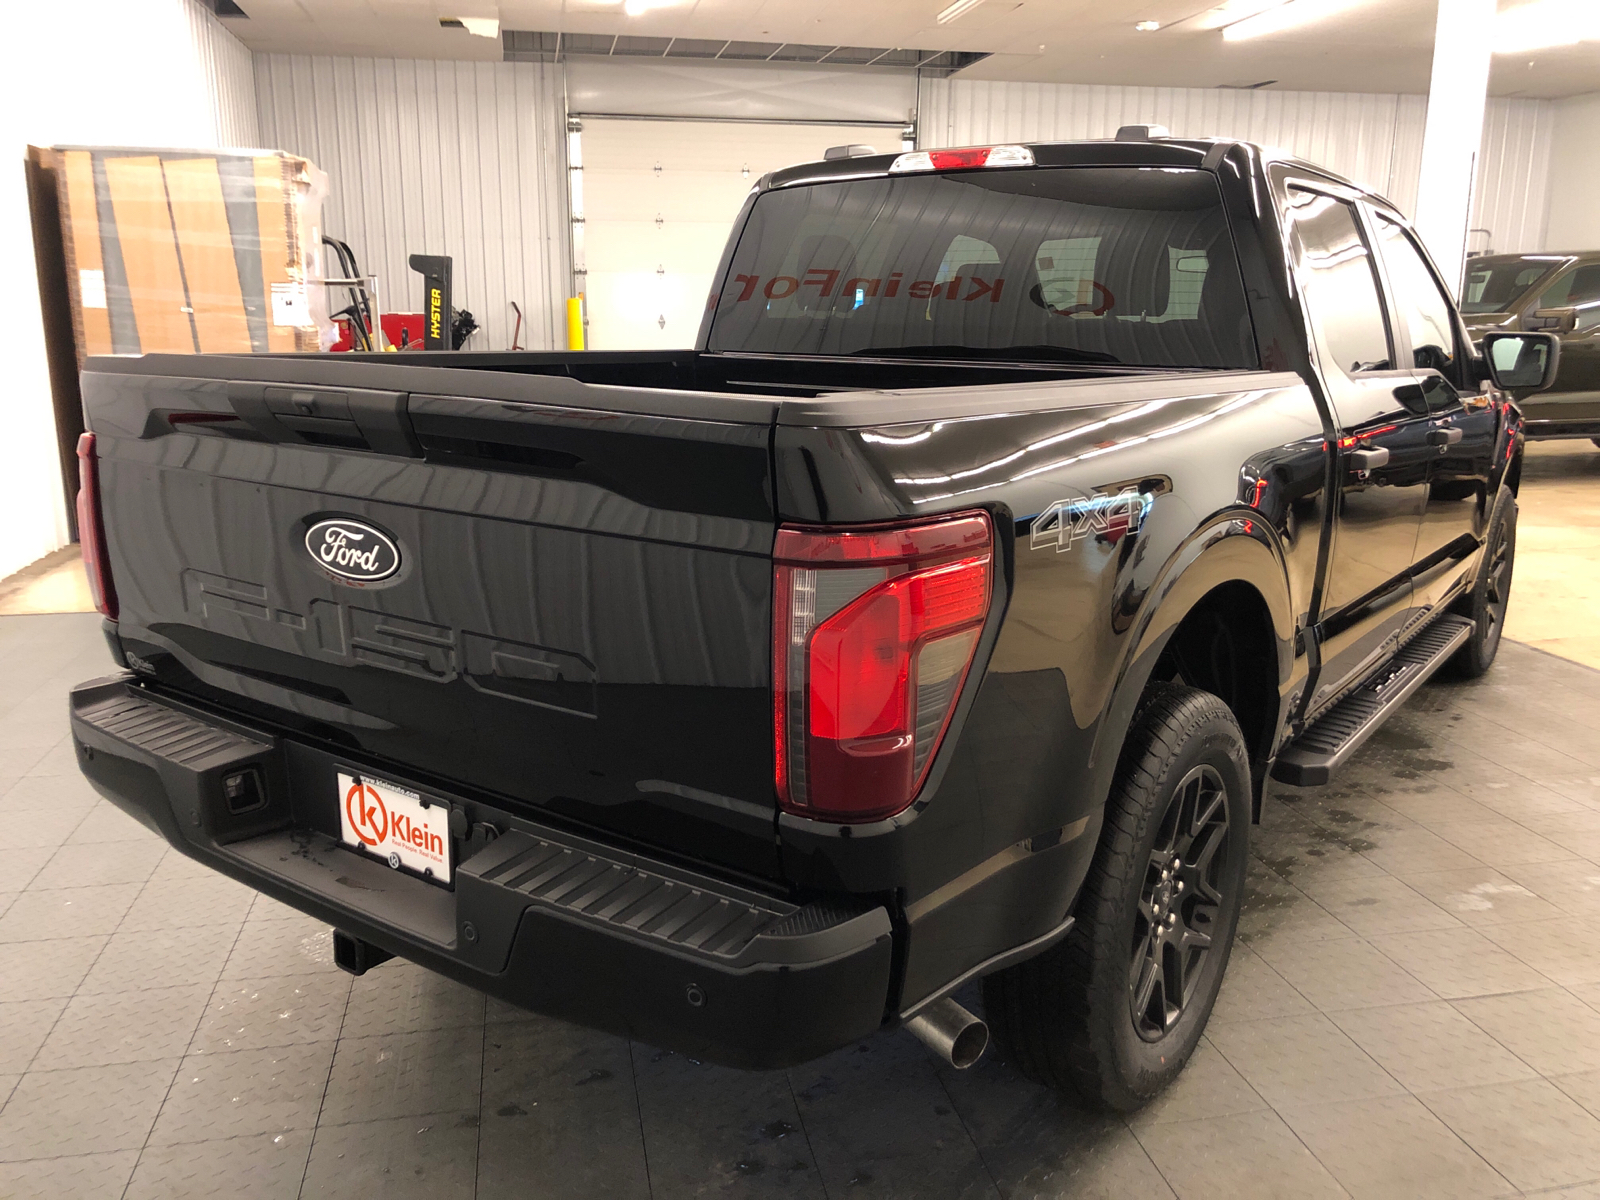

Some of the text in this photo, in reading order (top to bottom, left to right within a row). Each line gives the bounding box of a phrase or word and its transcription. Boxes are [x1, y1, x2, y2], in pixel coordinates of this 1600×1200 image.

[430, 288, 442, 339] HYSTER
[320, 527, 380, 572] Ford
[360, 776, 420, 800] www.kleinauto.com
[391, 811, 444, 856] Klein
[391, 839, 402, 848] Real
[418, 849, 430, 858] Real
